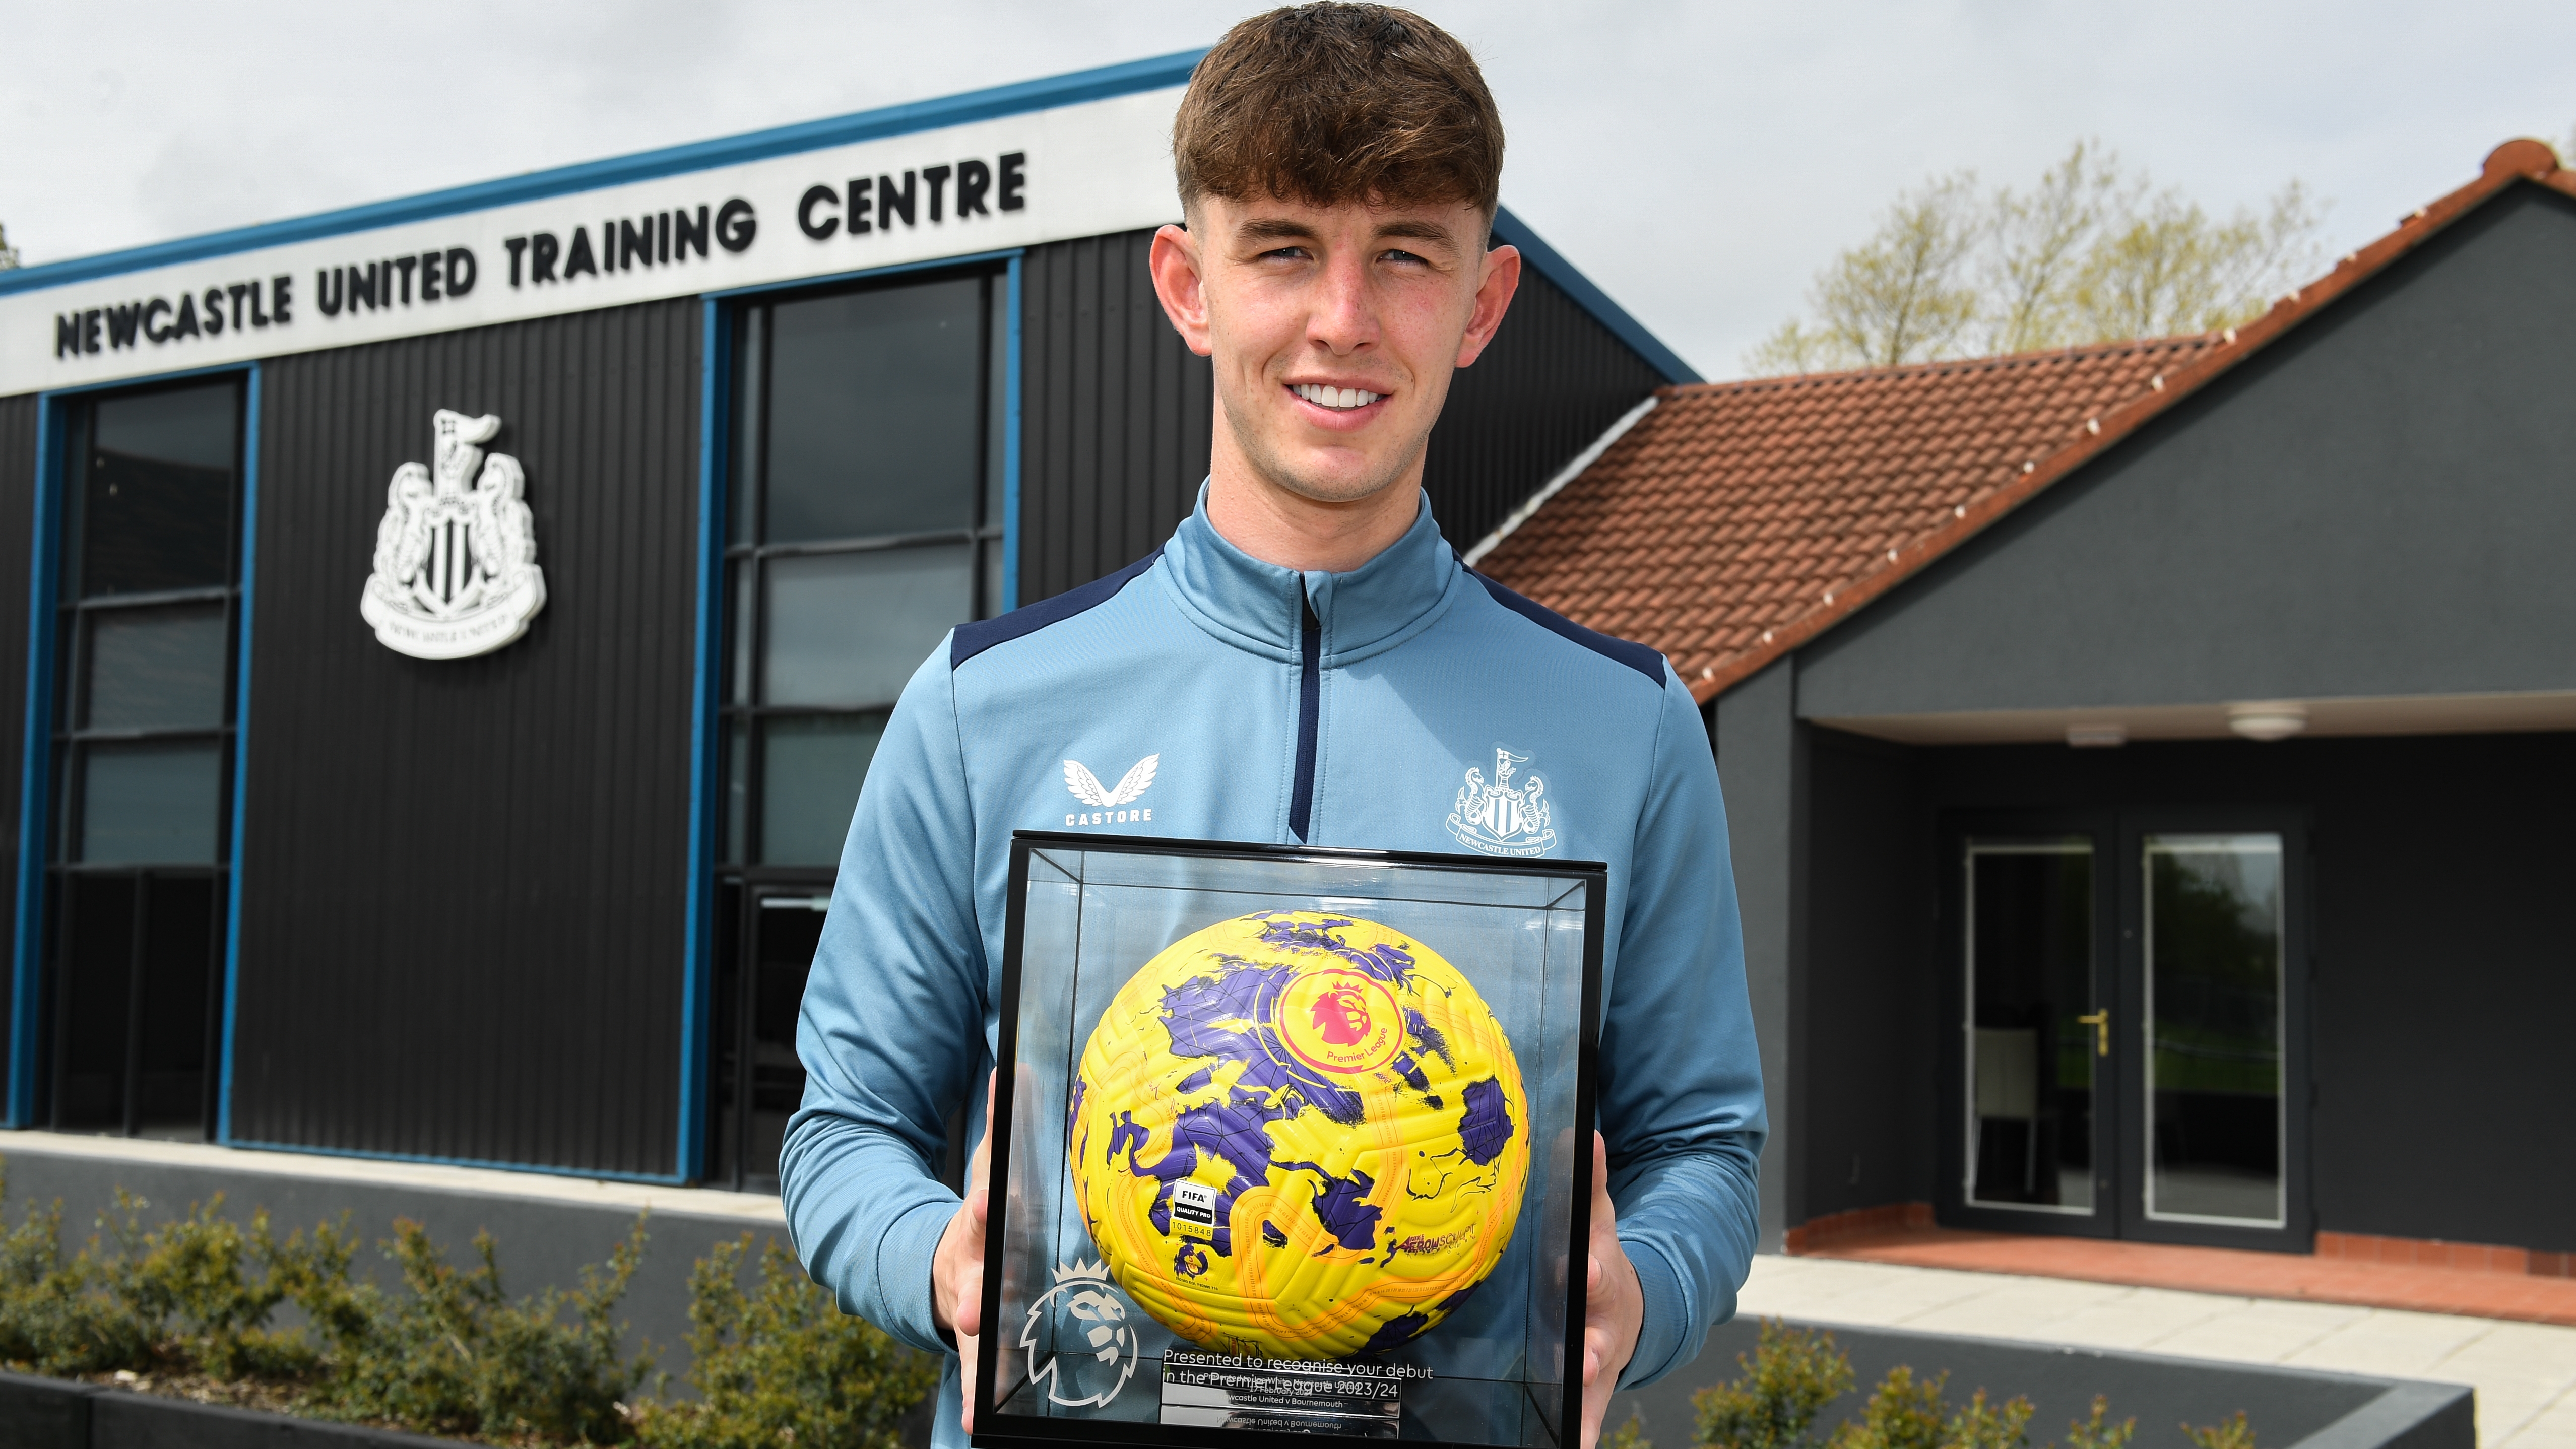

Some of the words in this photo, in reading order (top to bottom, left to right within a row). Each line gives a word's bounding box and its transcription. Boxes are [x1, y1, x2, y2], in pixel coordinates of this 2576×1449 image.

[55, 275, 291, 358] NEWCASTLE
[317, 247, 477, 316] UNITED
[505, 199, 756, 287] TRAINING
[798, 151, 1026, 241] CENTRE
[1065, 809, 1152, 826] CASTORE
[1459, 833, 1509, 855] NEWCASTLE
[1510, 846, 1541, 856] UNITED
[1327, 1051, 1365, 1062] Premier
[1364, 1028, 1387, 1056] League
[1176, 1207, 1199, 1216] QUALITY
[1172, 1222, 1211, 1236] 1015848
[1164, 1349, 1242, 1366] Presented
[1246, 1355, 1263, 1368] to
[1268, 1358, 1343, 1375] recognise
[1347, 1363, 1382, 1377] your
[1386, 1363, 1434, 1379] debut
[1163, 1367, 1175, 1382] in
[1180, 1369, 1205, 1384] the
[1210, 1372, 1270, 1389] Premier
[1275, 1376, 1333, 1396] League
[1337, 1380, 1398, 1399] 2023/24
[1260, 1387, 1294, 1396] February
[1259, 1396, 1283, 1404] United
[1292, 1398, 1343, 1408] Bournemouth
